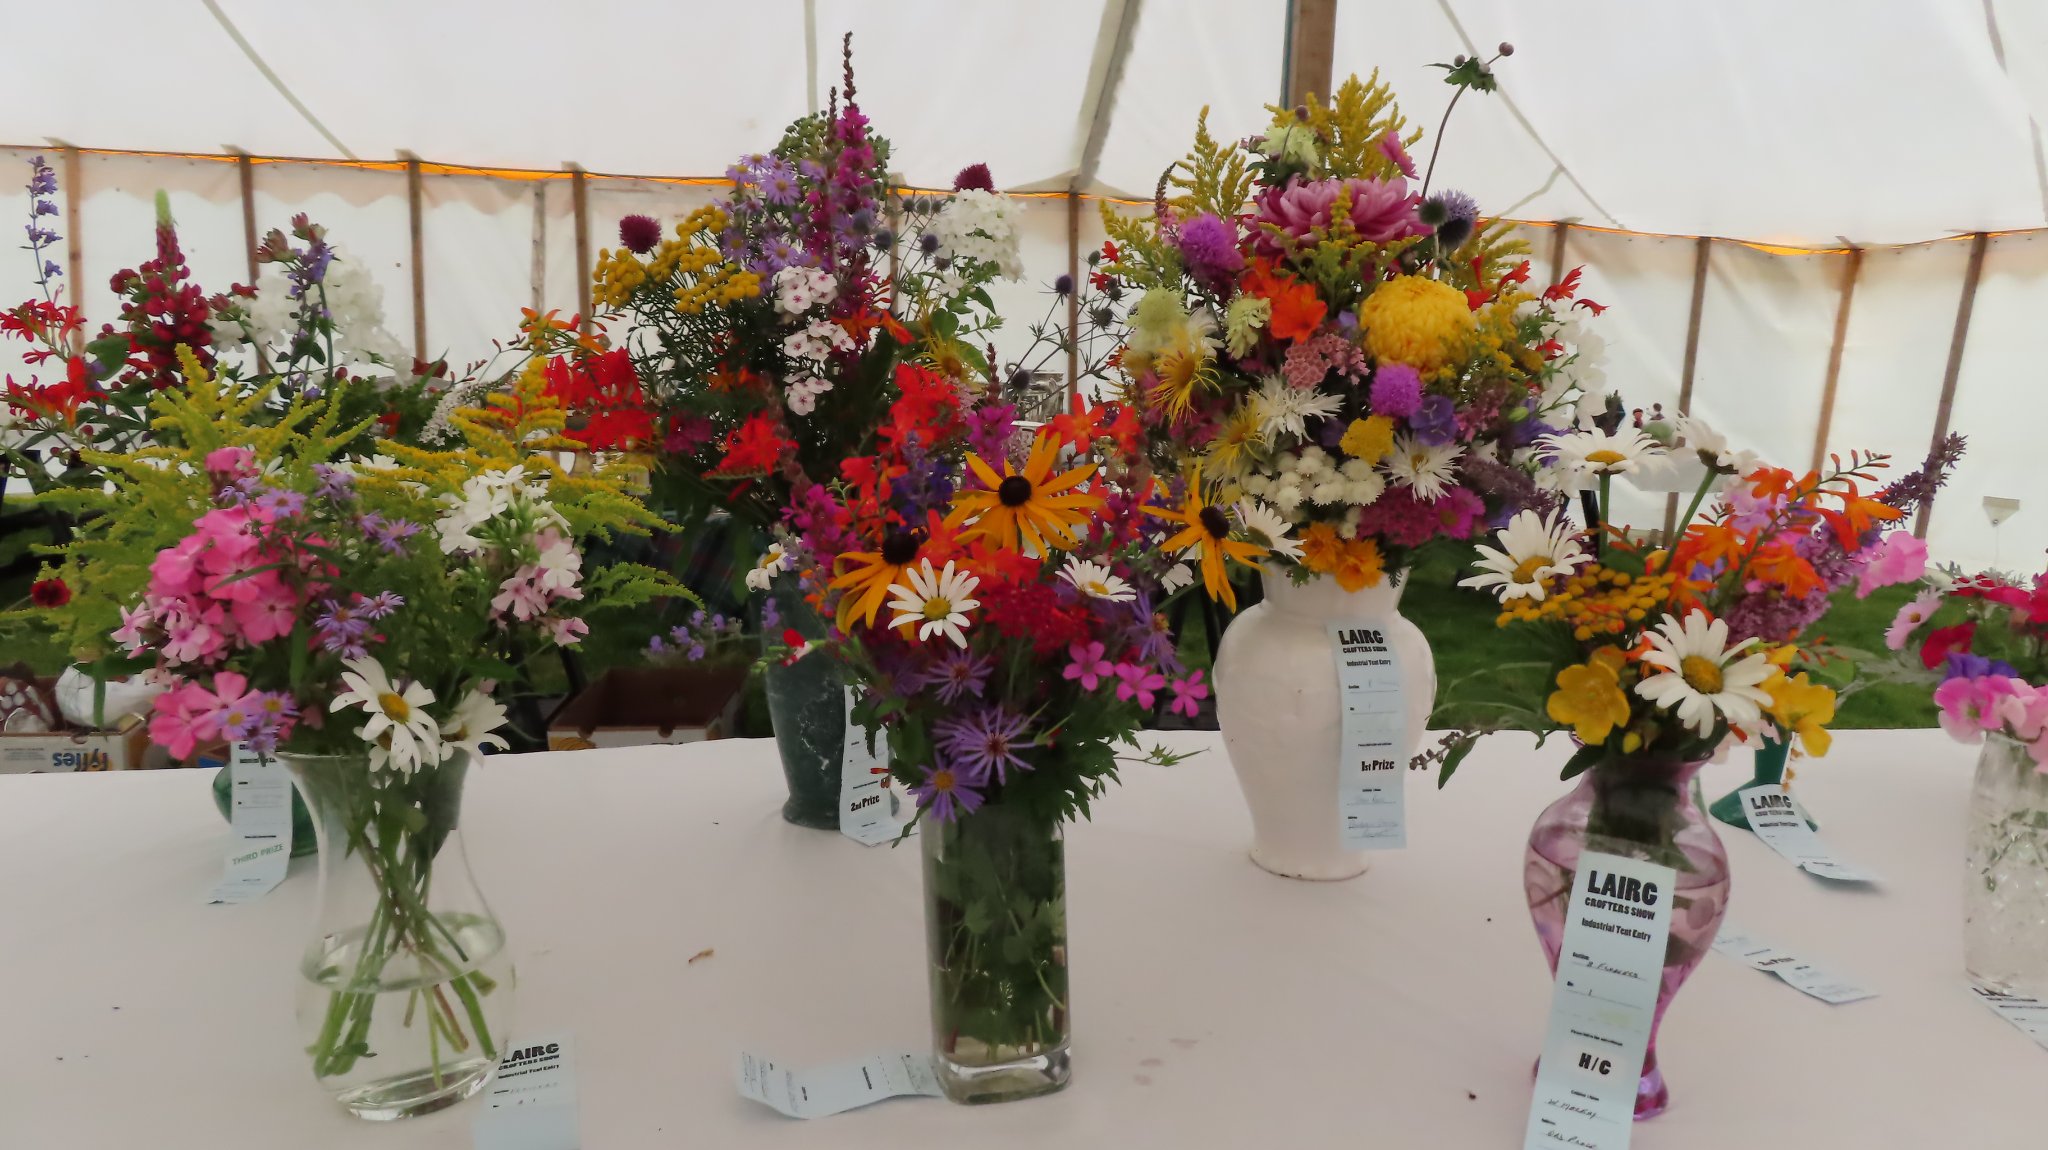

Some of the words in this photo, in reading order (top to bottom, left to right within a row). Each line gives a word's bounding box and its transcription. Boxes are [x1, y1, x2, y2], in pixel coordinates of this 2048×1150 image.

[1338, 629, 1383, 645] LAIRG
[1372, 760, 1395, 771] Prize
[862, 795, 880, 808] Prize
[1588, 870, 1658, 906] LAIRG
[1585, 897, 1630, 915] CROFTERS
[1631, 907, 1656, 921] SHOW
[1582, 917, 1615, 933] Industrial
[1616, 925, 1632, 937] Tent
[1632, 929, 1652, 943] Entry
[1579, 1052, 1612, 1075] H/C
